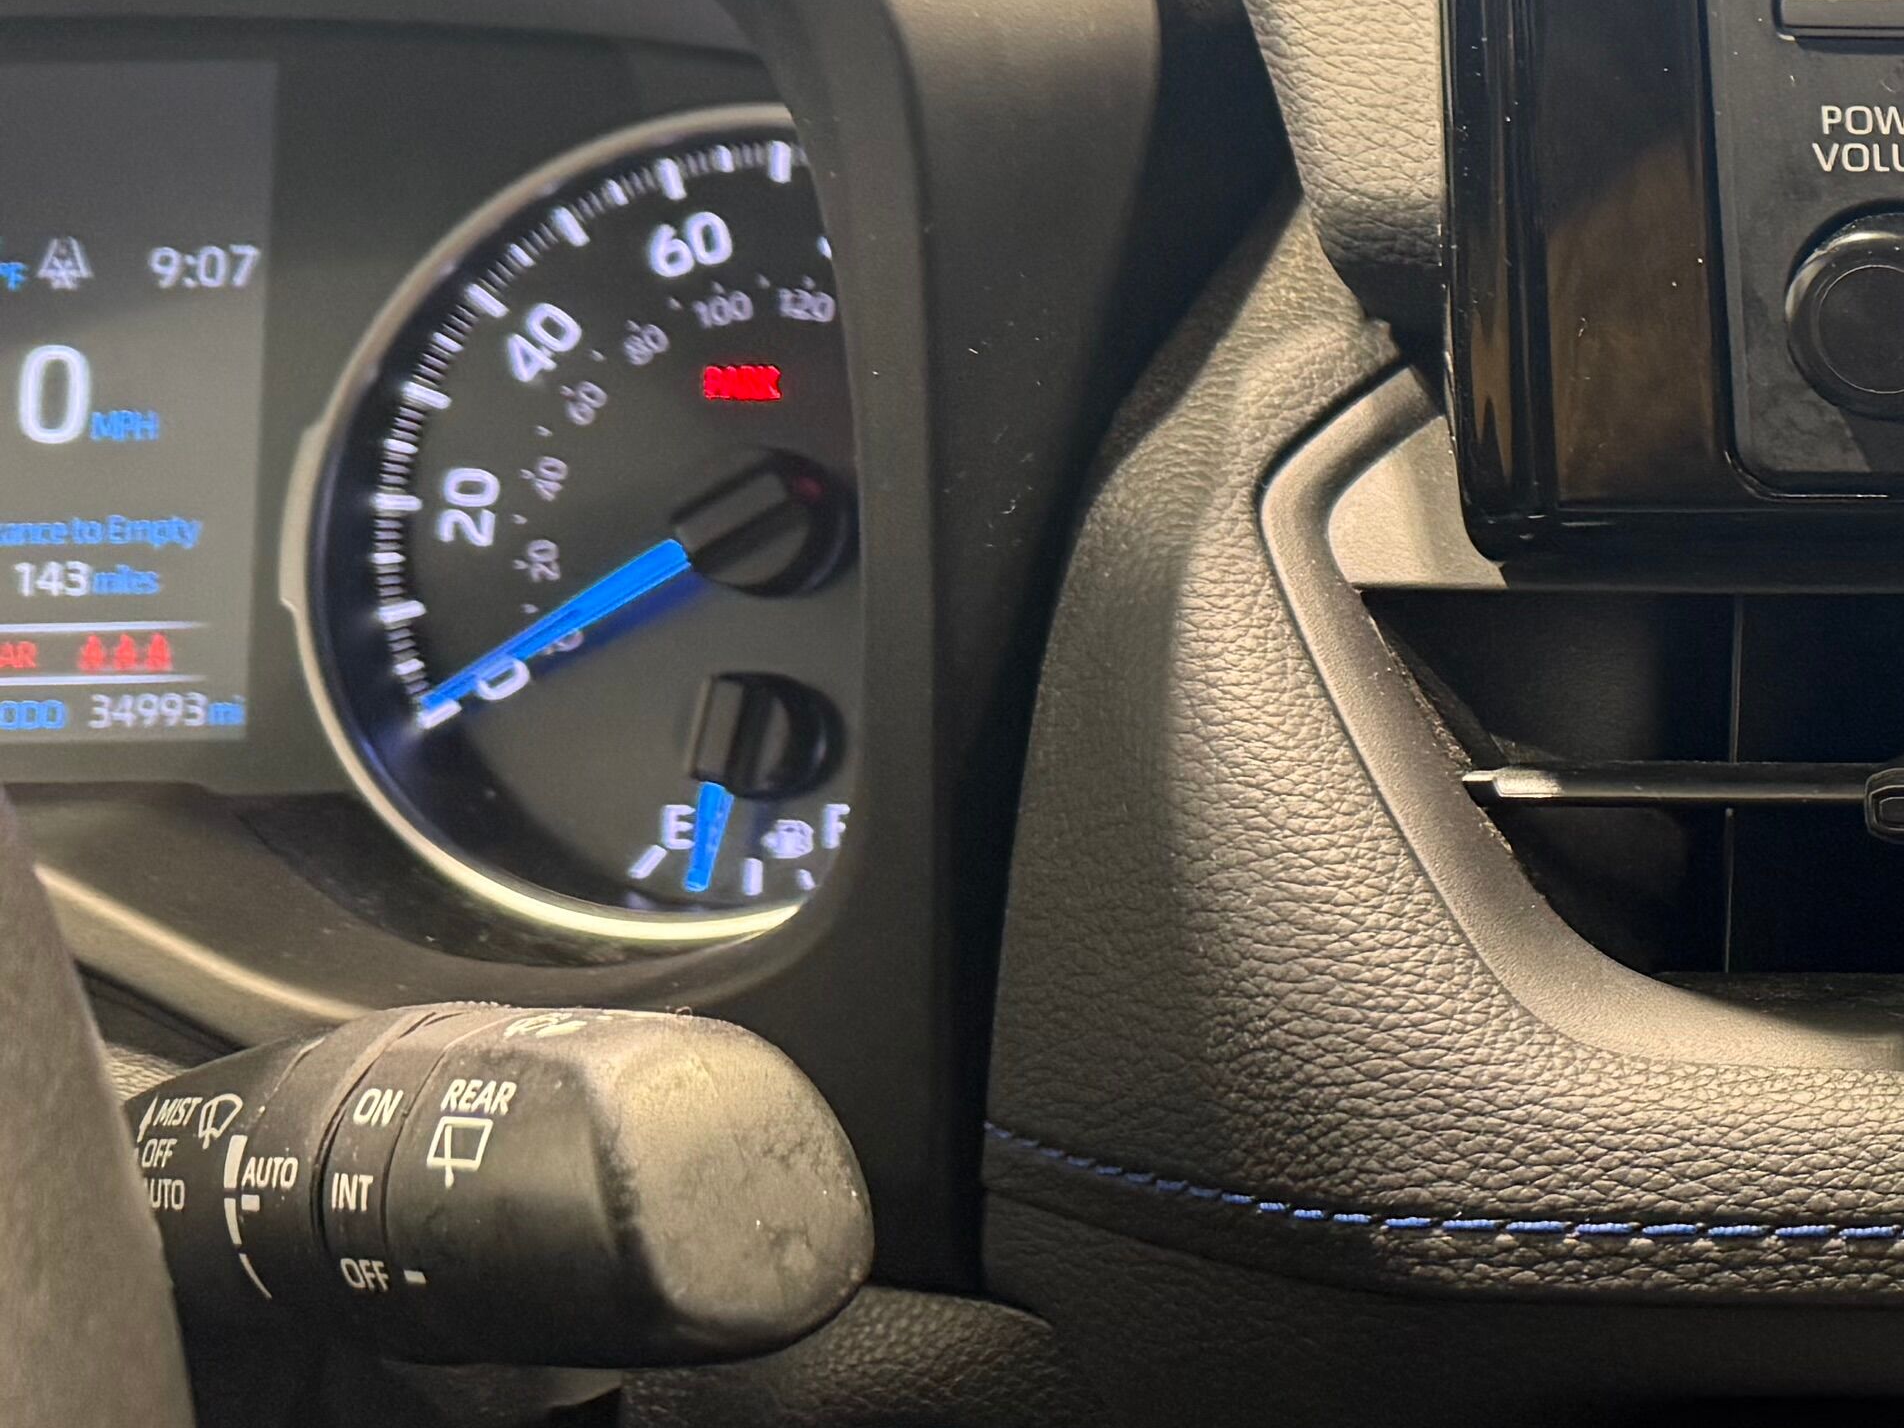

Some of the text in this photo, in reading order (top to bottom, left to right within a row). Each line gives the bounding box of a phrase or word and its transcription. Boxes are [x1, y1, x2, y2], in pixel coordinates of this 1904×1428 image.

[649, 211, 734, 278] 60
[148, 245, 261, 289] 9:07
[507, 303, 582, 383] 40
[18, 344, 91, 445] 0
[436, 468, 500, 547] 20
[106, 514, 203, 551] Empty
[14, 560, 90, 597] 143
[88, 692, 208, 729] 34993
[661, 804, 696, 850] E
[823, 803, 851, 849] F
[157, 1097, 203, 1128] MIST
[353, 1088, 404, 1127] ON
[441, 1079, 519, 1115] REAR
[141, 1138, 177, 1169] OFF
[241, 1156, 299, 1189] AUTO
[331, 1173, 374, 1212] INT
[340, 1258, 390, 1292] OFF
